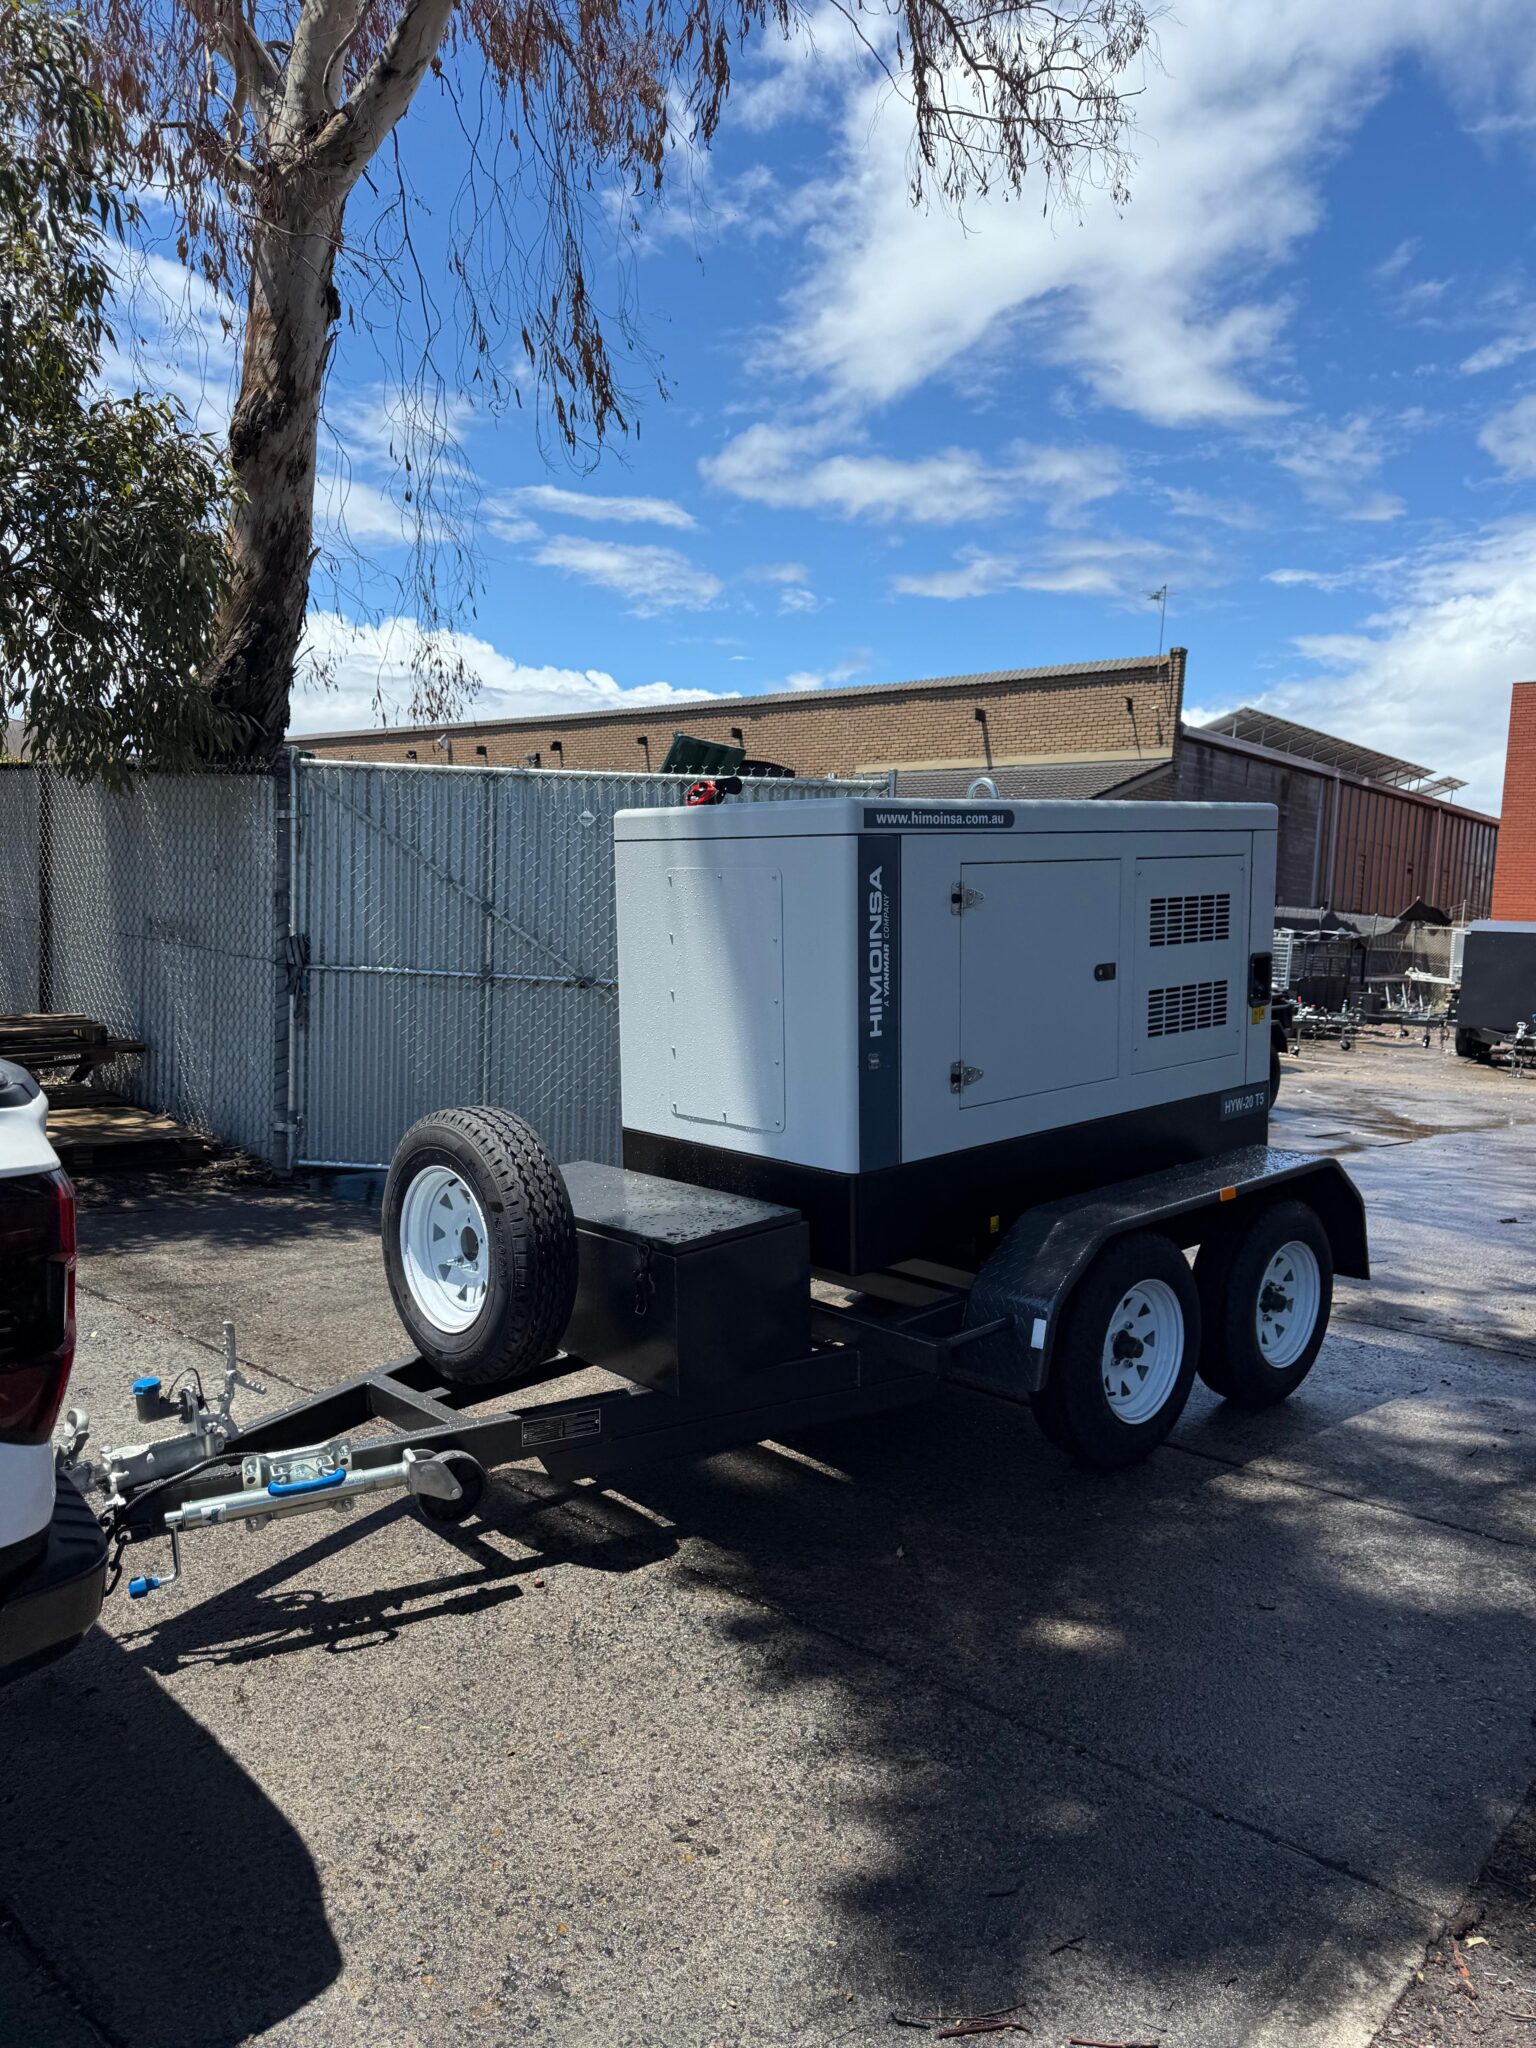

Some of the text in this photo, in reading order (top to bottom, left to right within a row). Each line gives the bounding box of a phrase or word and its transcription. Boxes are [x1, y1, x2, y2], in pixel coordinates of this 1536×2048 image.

[876, 811, 1004, 825] www.himoinsa.com.au
[869, 865, 883, 1037] HIMOINSA
[1225, 1092, 1264, 1114] HYW-20 T5
